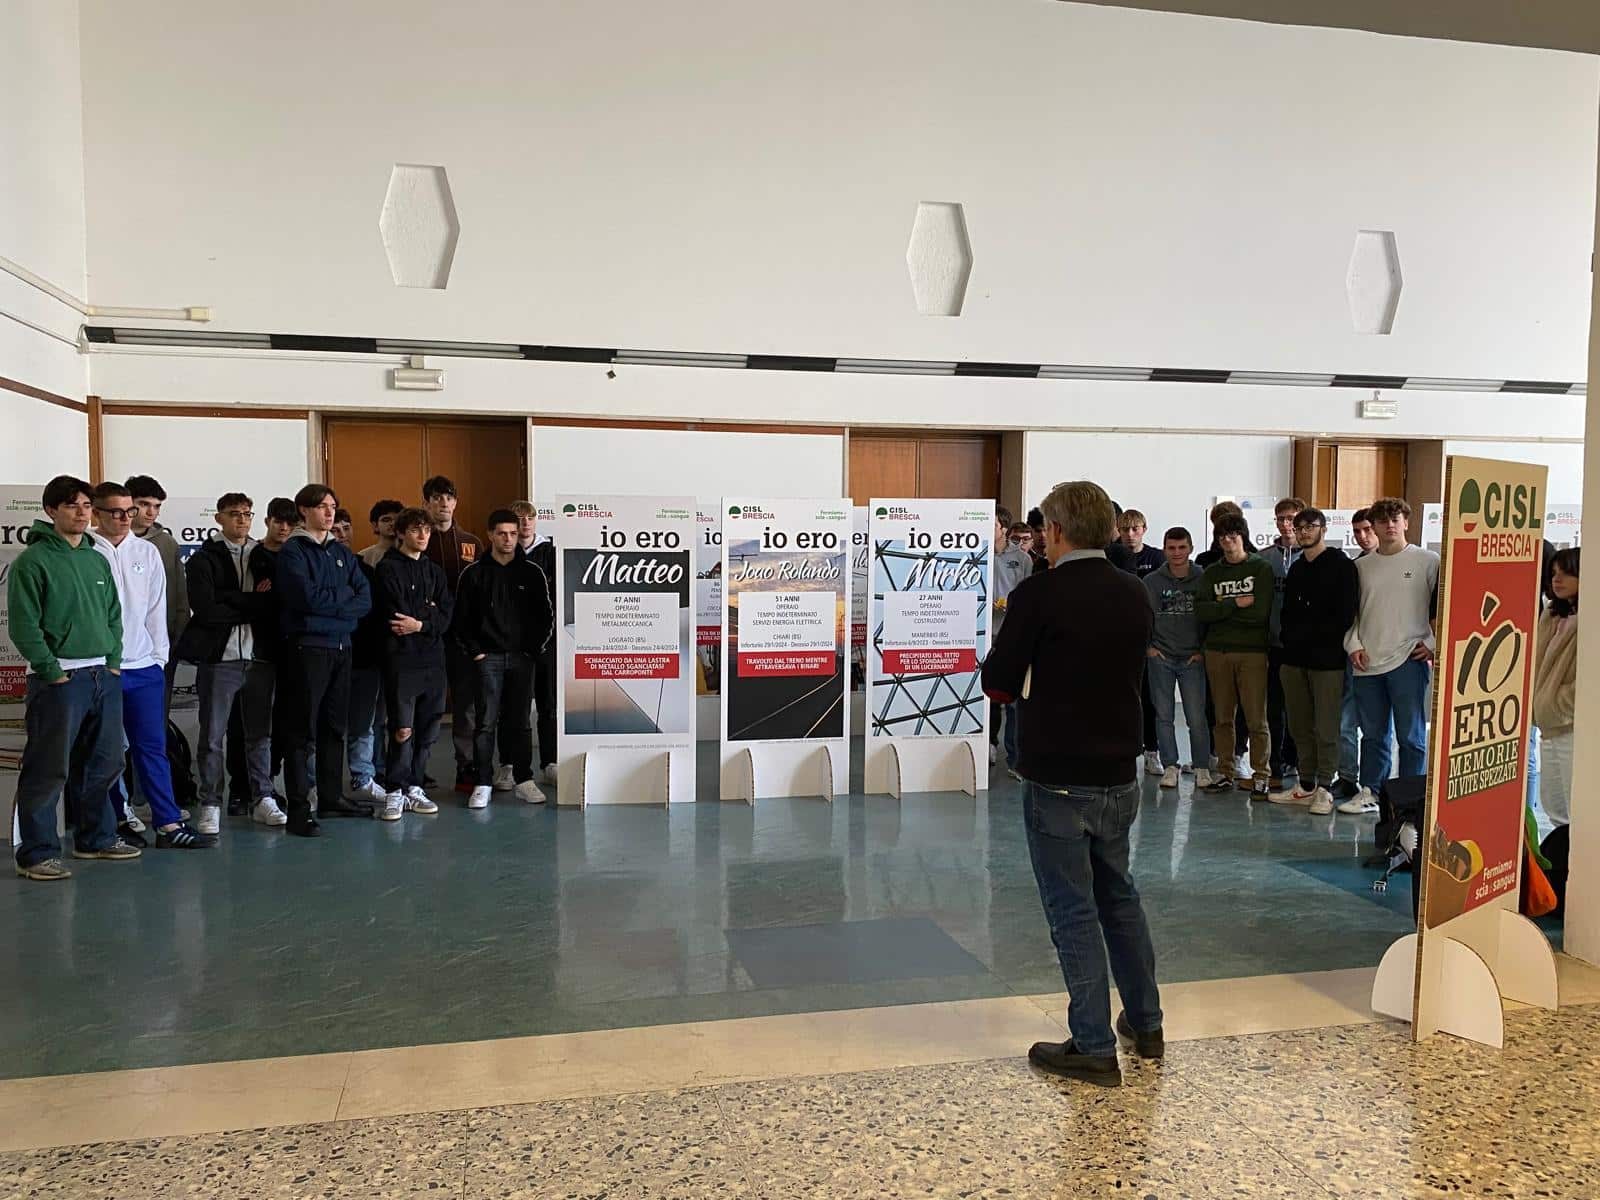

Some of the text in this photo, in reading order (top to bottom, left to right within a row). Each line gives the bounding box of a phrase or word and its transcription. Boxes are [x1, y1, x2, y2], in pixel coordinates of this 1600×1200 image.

[1484, 482, 1541, 529] CISL
[1, 526, 31, 545] ro
[600, 525, 680, 548] io ero
[763, 527, 837, 548] io ero
[852, 532, 868, 545] er
[908, 527, 979, 548] io ero
[1481, 533, 1531, 557] BRESCIA
[582, 553, 684, 585] Matteo
[777, 558, 841, 580] Rolando
[905, 555, 982, 589] Mirko
[1452, 694, 1520, 750] ERO
[1449, 740, 1519, 779] MEMORIE
[1448, 761, 1518, 800] DI VITE SPEZZATE
[1475, 882, 1489, 900] scia
[1493, 872, 1515, 891] sangue
